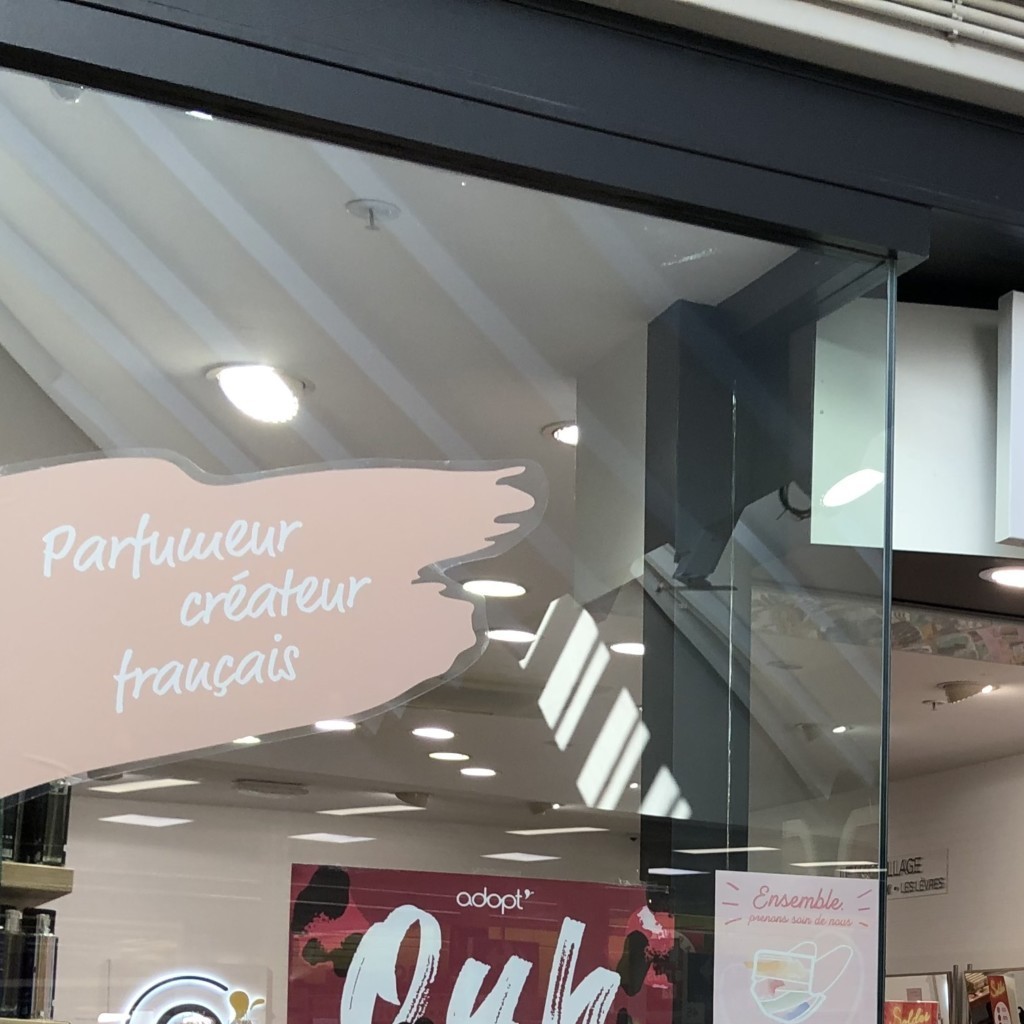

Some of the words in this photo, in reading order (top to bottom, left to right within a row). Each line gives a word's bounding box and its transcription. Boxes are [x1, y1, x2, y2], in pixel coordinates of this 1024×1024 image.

[42, 513, 302, 579] Parfumeur
[180, 569, 372, 627] créateur
[113, 634, 300, 713] français
[791, 913, 812, 925] soin
[814, 914, 826, 926] de
[828, 917, 853, 927] nous
